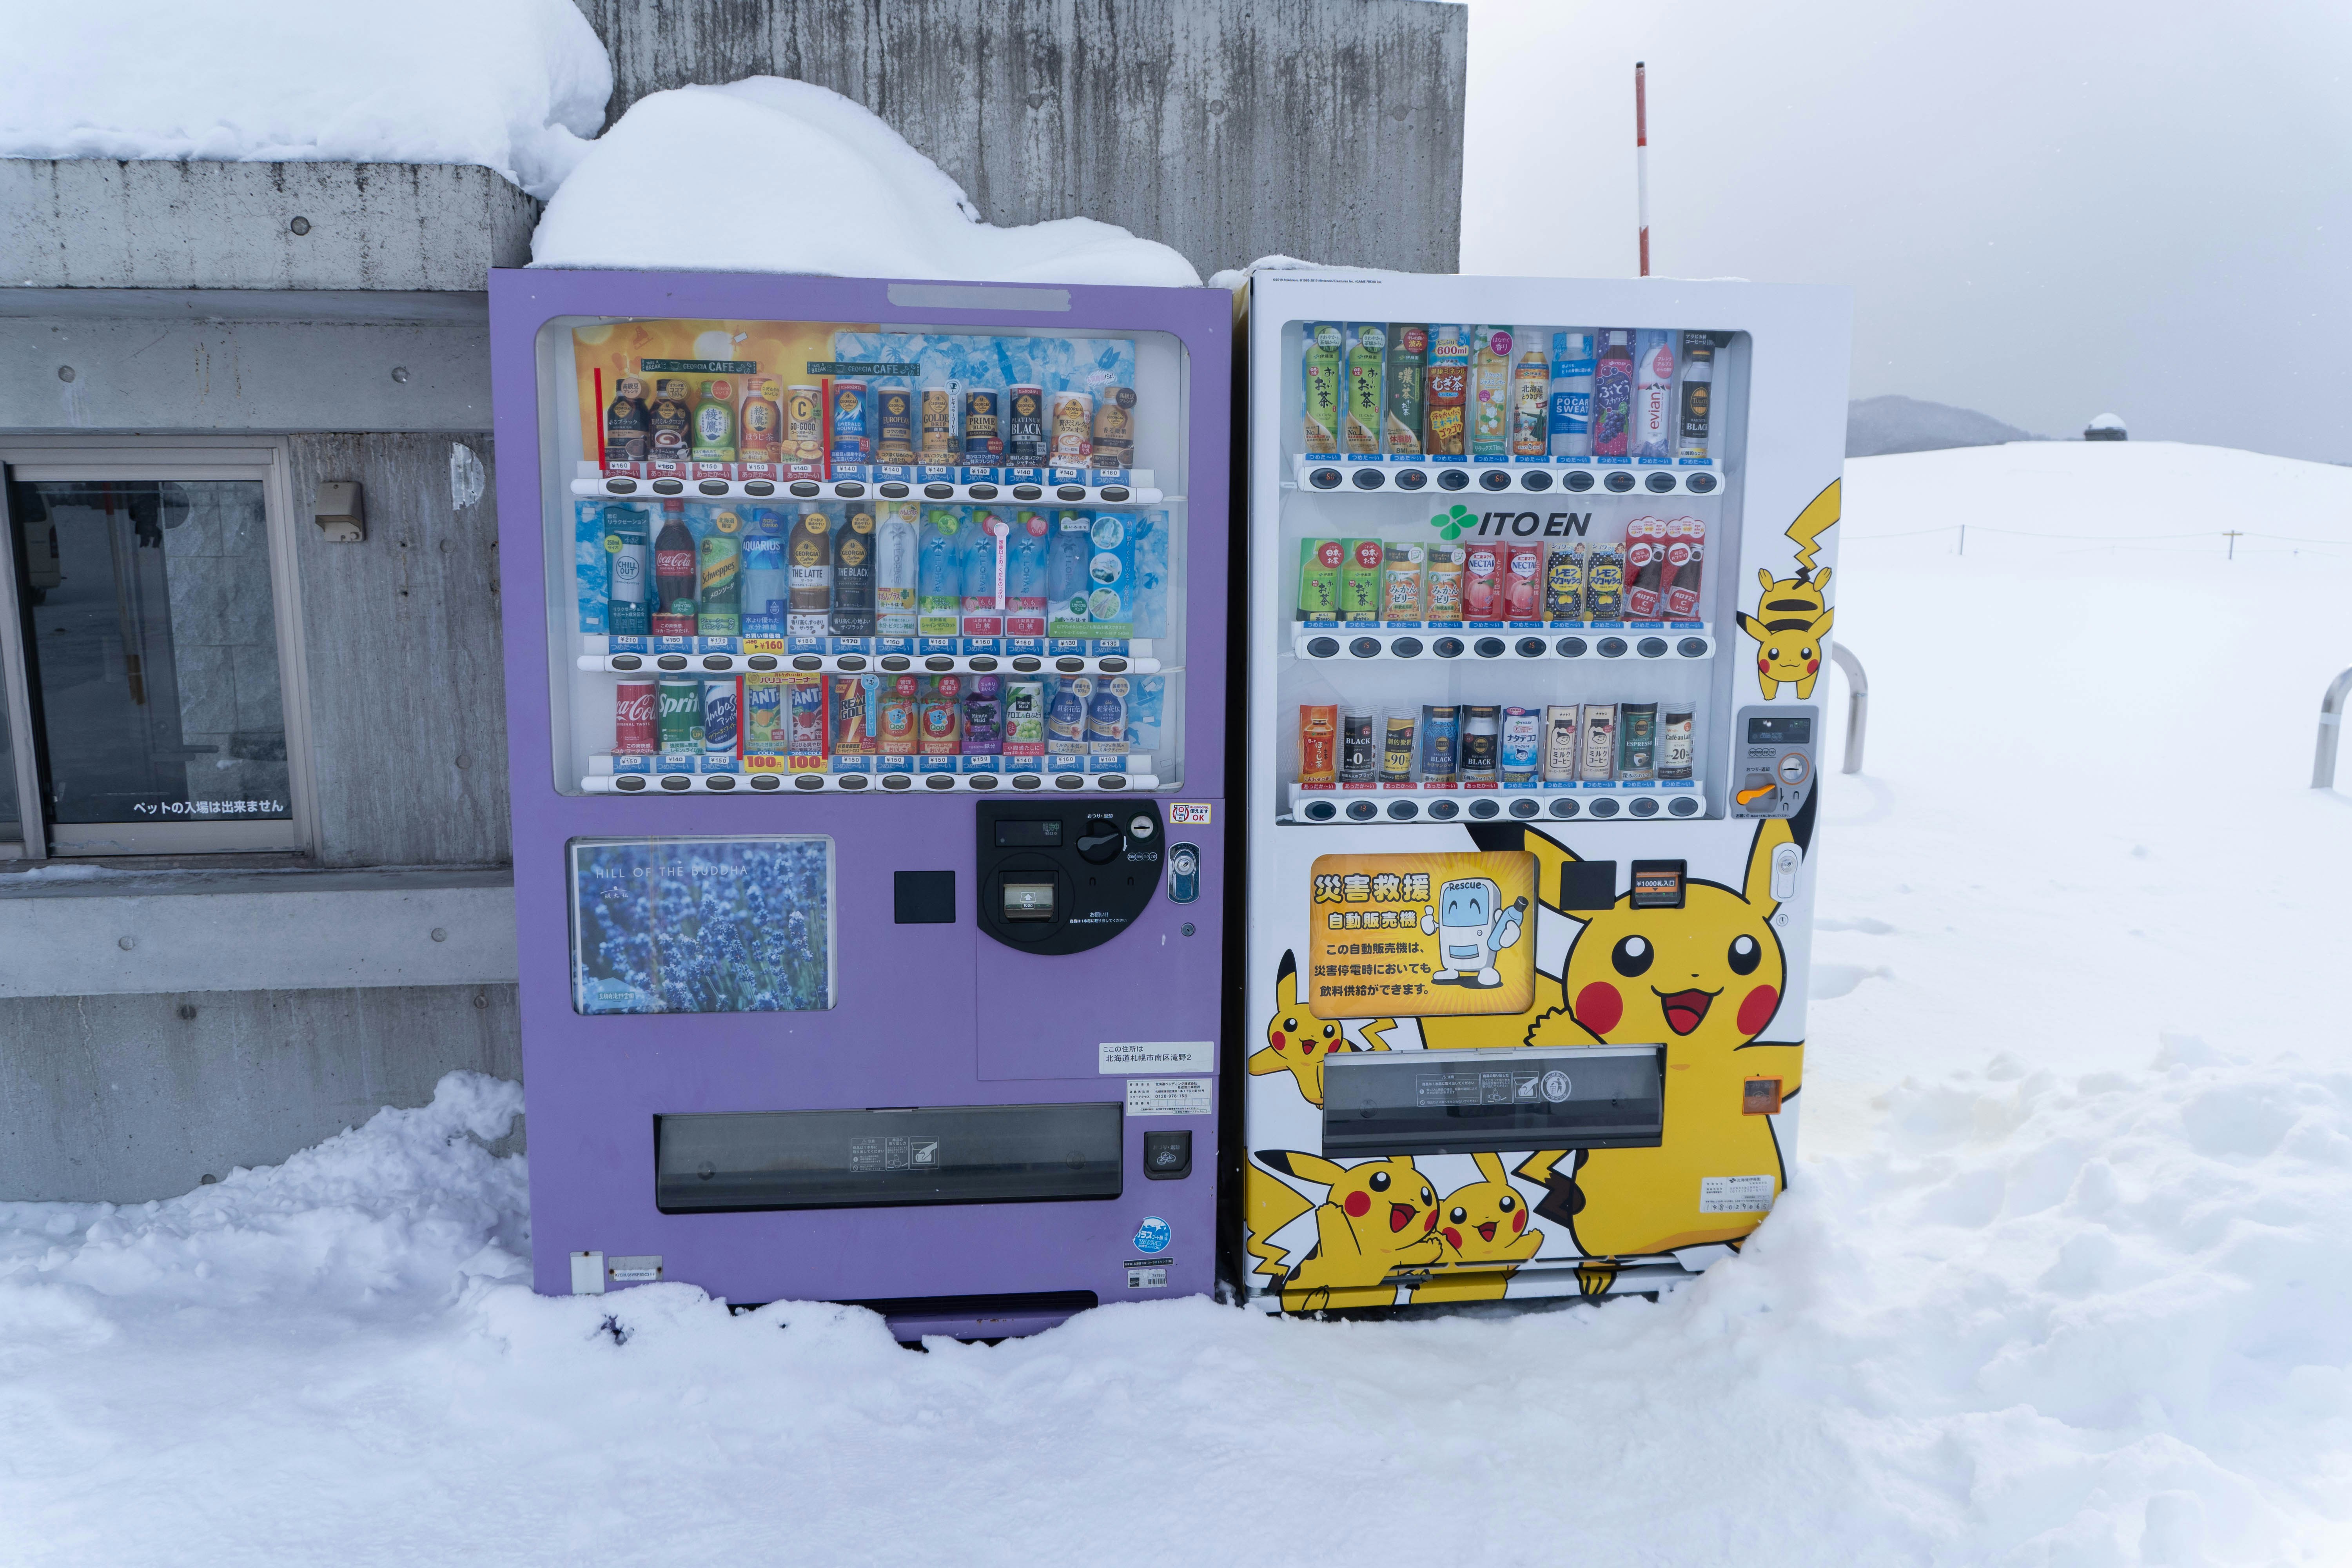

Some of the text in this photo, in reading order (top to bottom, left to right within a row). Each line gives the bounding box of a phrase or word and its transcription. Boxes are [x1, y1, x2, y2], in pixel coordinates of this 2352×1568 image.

[1437, 346, 1467, 355] 600ml
[708, 362, 734, 372] CAFE
[873, 365, 898, 374] CAFE
[1432, 376, 1464, 391] むぎ茶
[1600, 380, 1630, 398] ぶどう
[1650, 391, 1661, 430] evian
[705, 409, 719, 433] 綾鷹
[1012, 424, 1041, 435] BLACK
[1306, 425, 1321, 436] No.1
[1439, 423, 1461, 437] ゴクゴク
[746, 433, 774, 441] ほうじ茶
[1478, 512, 1592, 536] ITO EN
[744, 541, 780, 551] AQUARIUS
[657, 553, 691, 567] Coca-Cola
[702, 562, 735, 584] Schweppes
[792, 569, 823, 578] THE LATTE
[838, 568, 868, 577] THE BLACK
[1555, 568, 1578, 577] レモン
[1550, 576, 1581, 584] スカッシュ
[710, 582, 735, 599] メロンソーダ
[1390, 585, 1417, 593] みかん
[1392, 595, 1415, 603] ゼリー
[760, 641, 782, 650] ¥160
[1391, 754, 1405, 765] 90
[1673, 748, 1686, 760] 20
[747, 756, 781, 768] 100円
[789, 756, 827, 768] 100円
[134, 801, 284, 815] ペットの入場は出来ません
[1043, 823, 1060, 832] 販売中
[596, 866, 747, 878] HILL OF THE BUDDHA
[1314, 873, 1431, 904] 災害救援
[1449, 881, 1482, 891] Rescue
[1328, 910, 1417, 930] 自動販売機
[1326, 943, 1424, 955] この自動販売機は、
[1314, 964, 1431, 977] 災害停電時においても
[1319, 984, 1429, 996] 飲料供給ができます。
